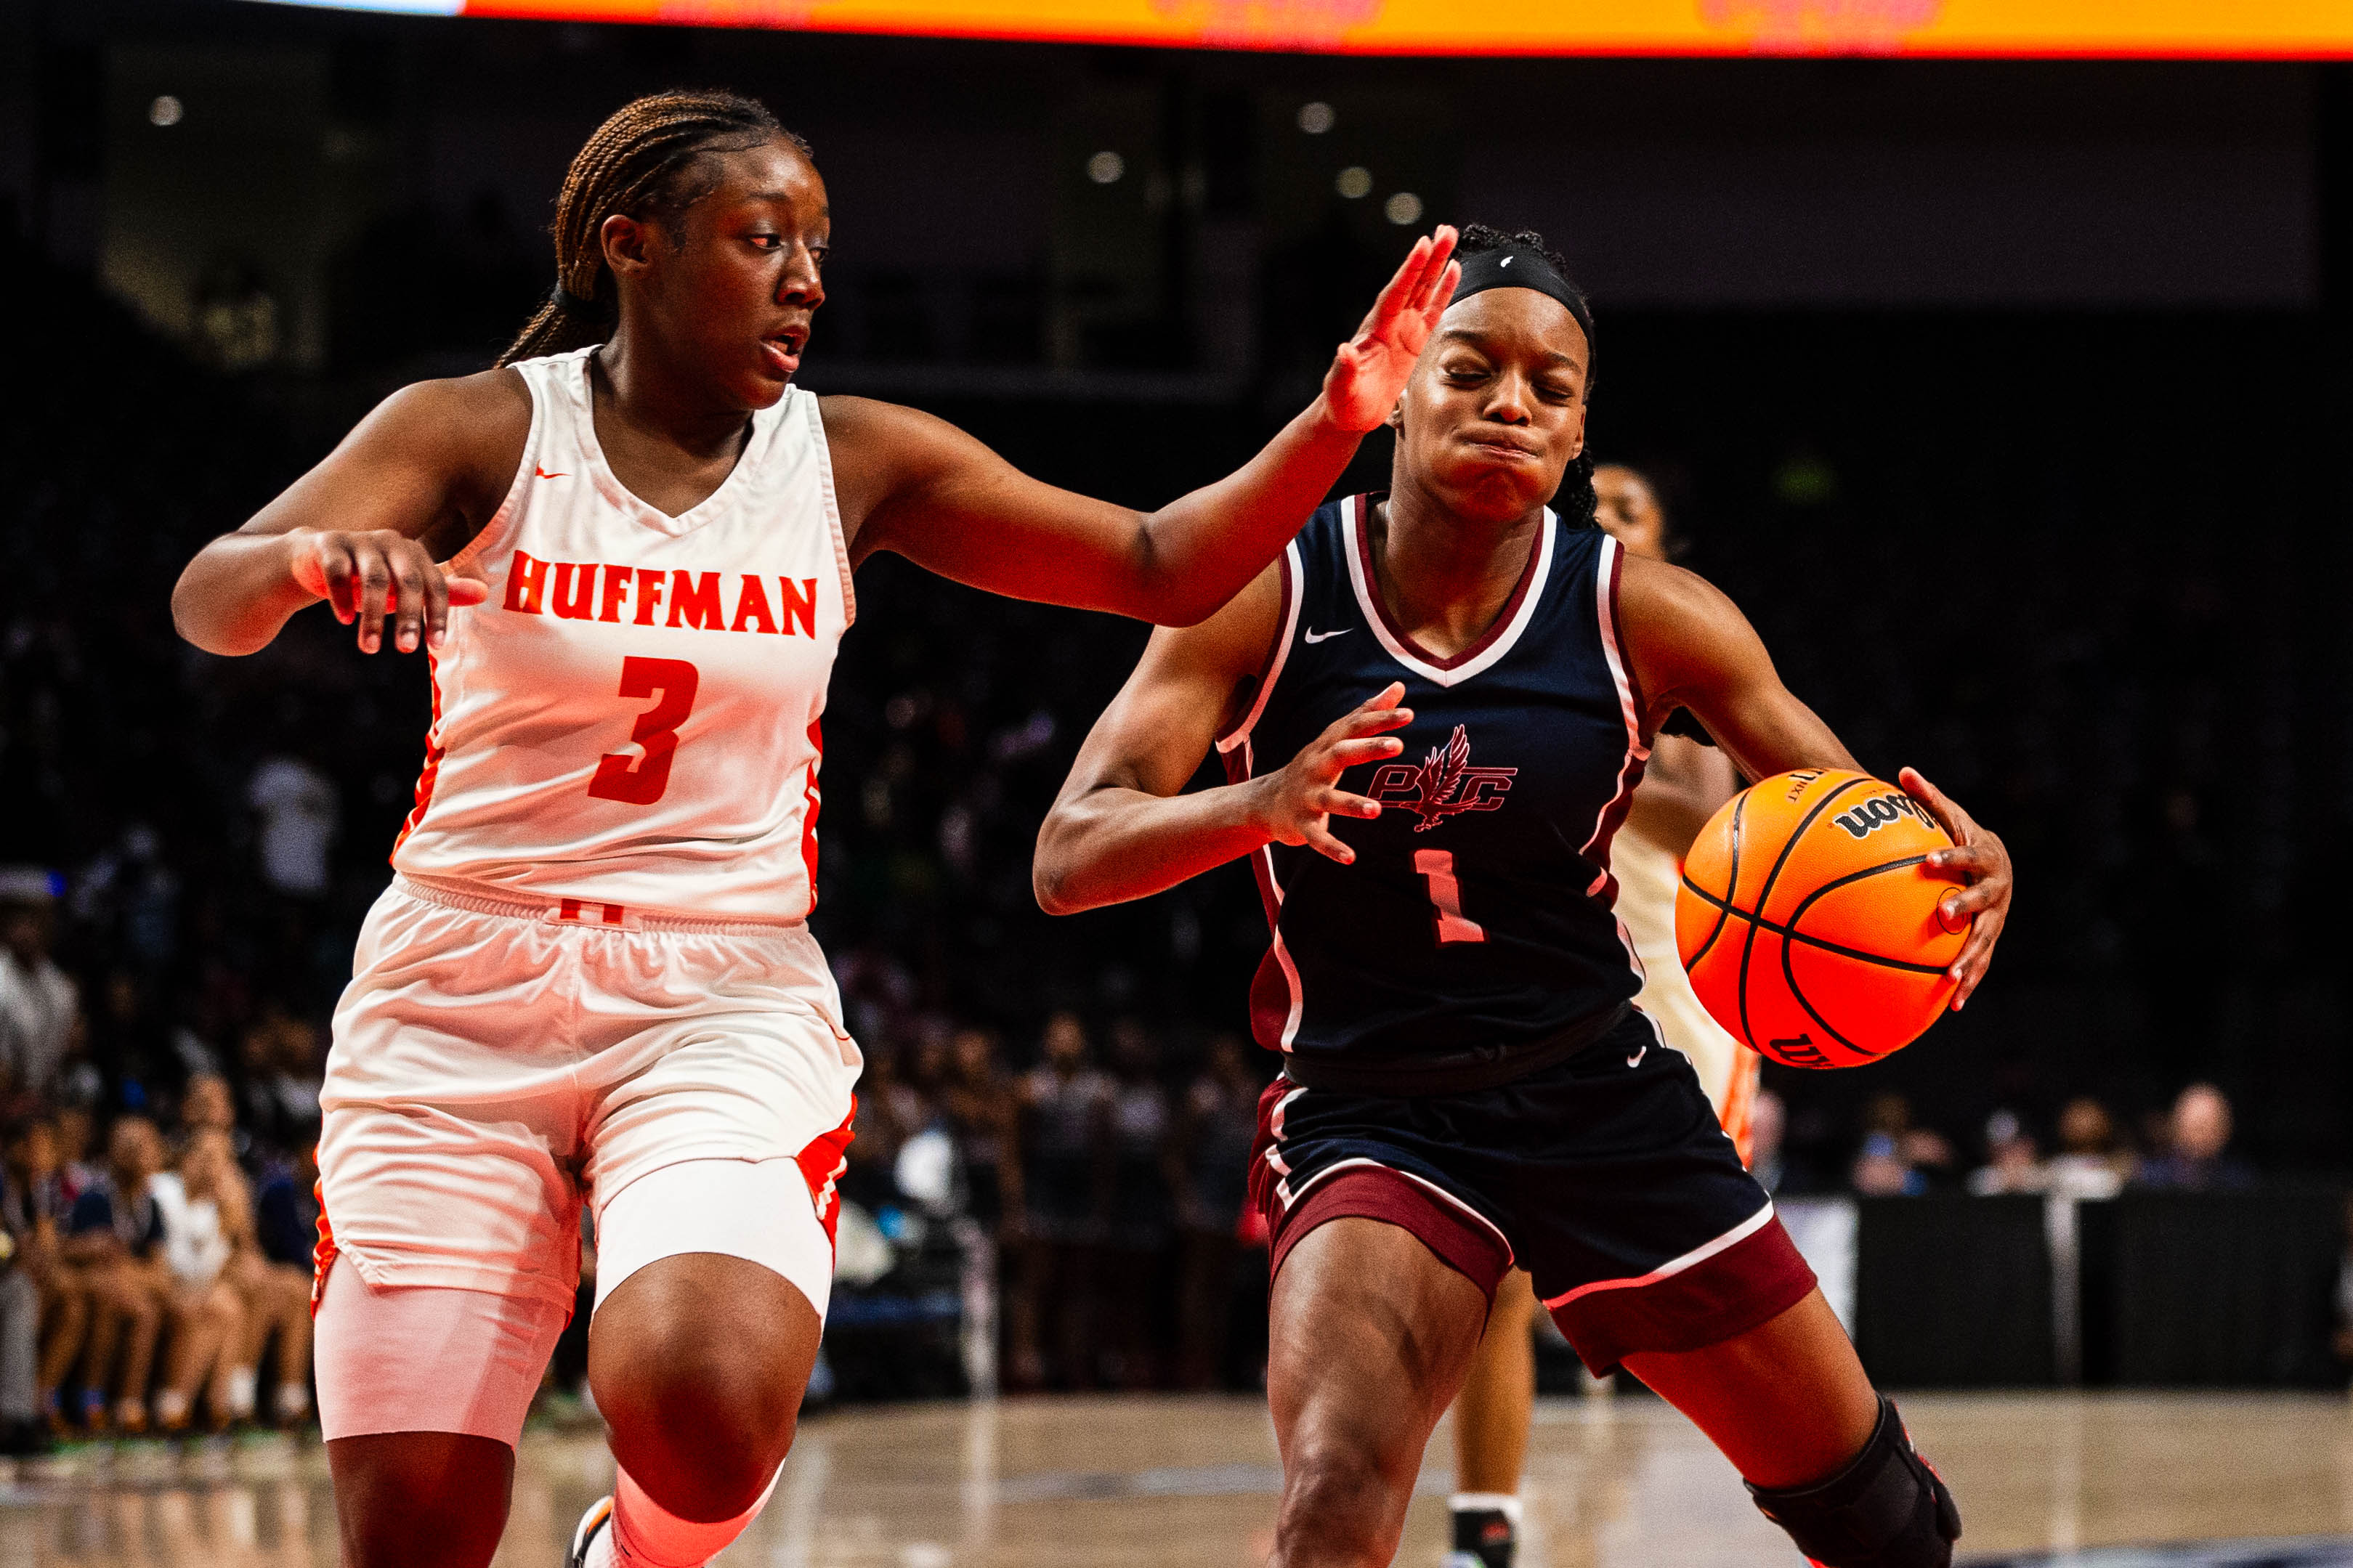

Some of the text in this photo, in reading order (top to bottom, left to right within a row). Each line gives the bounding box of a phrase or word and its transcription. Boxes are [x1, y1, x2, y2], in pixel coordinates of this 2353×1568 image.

[503, 550, 818, 640] HUFFMAN
[587, 656, 698, 805] 3
[1833, 793, 1937, 838] lson
[1412, 848, 1487, 946] 1
